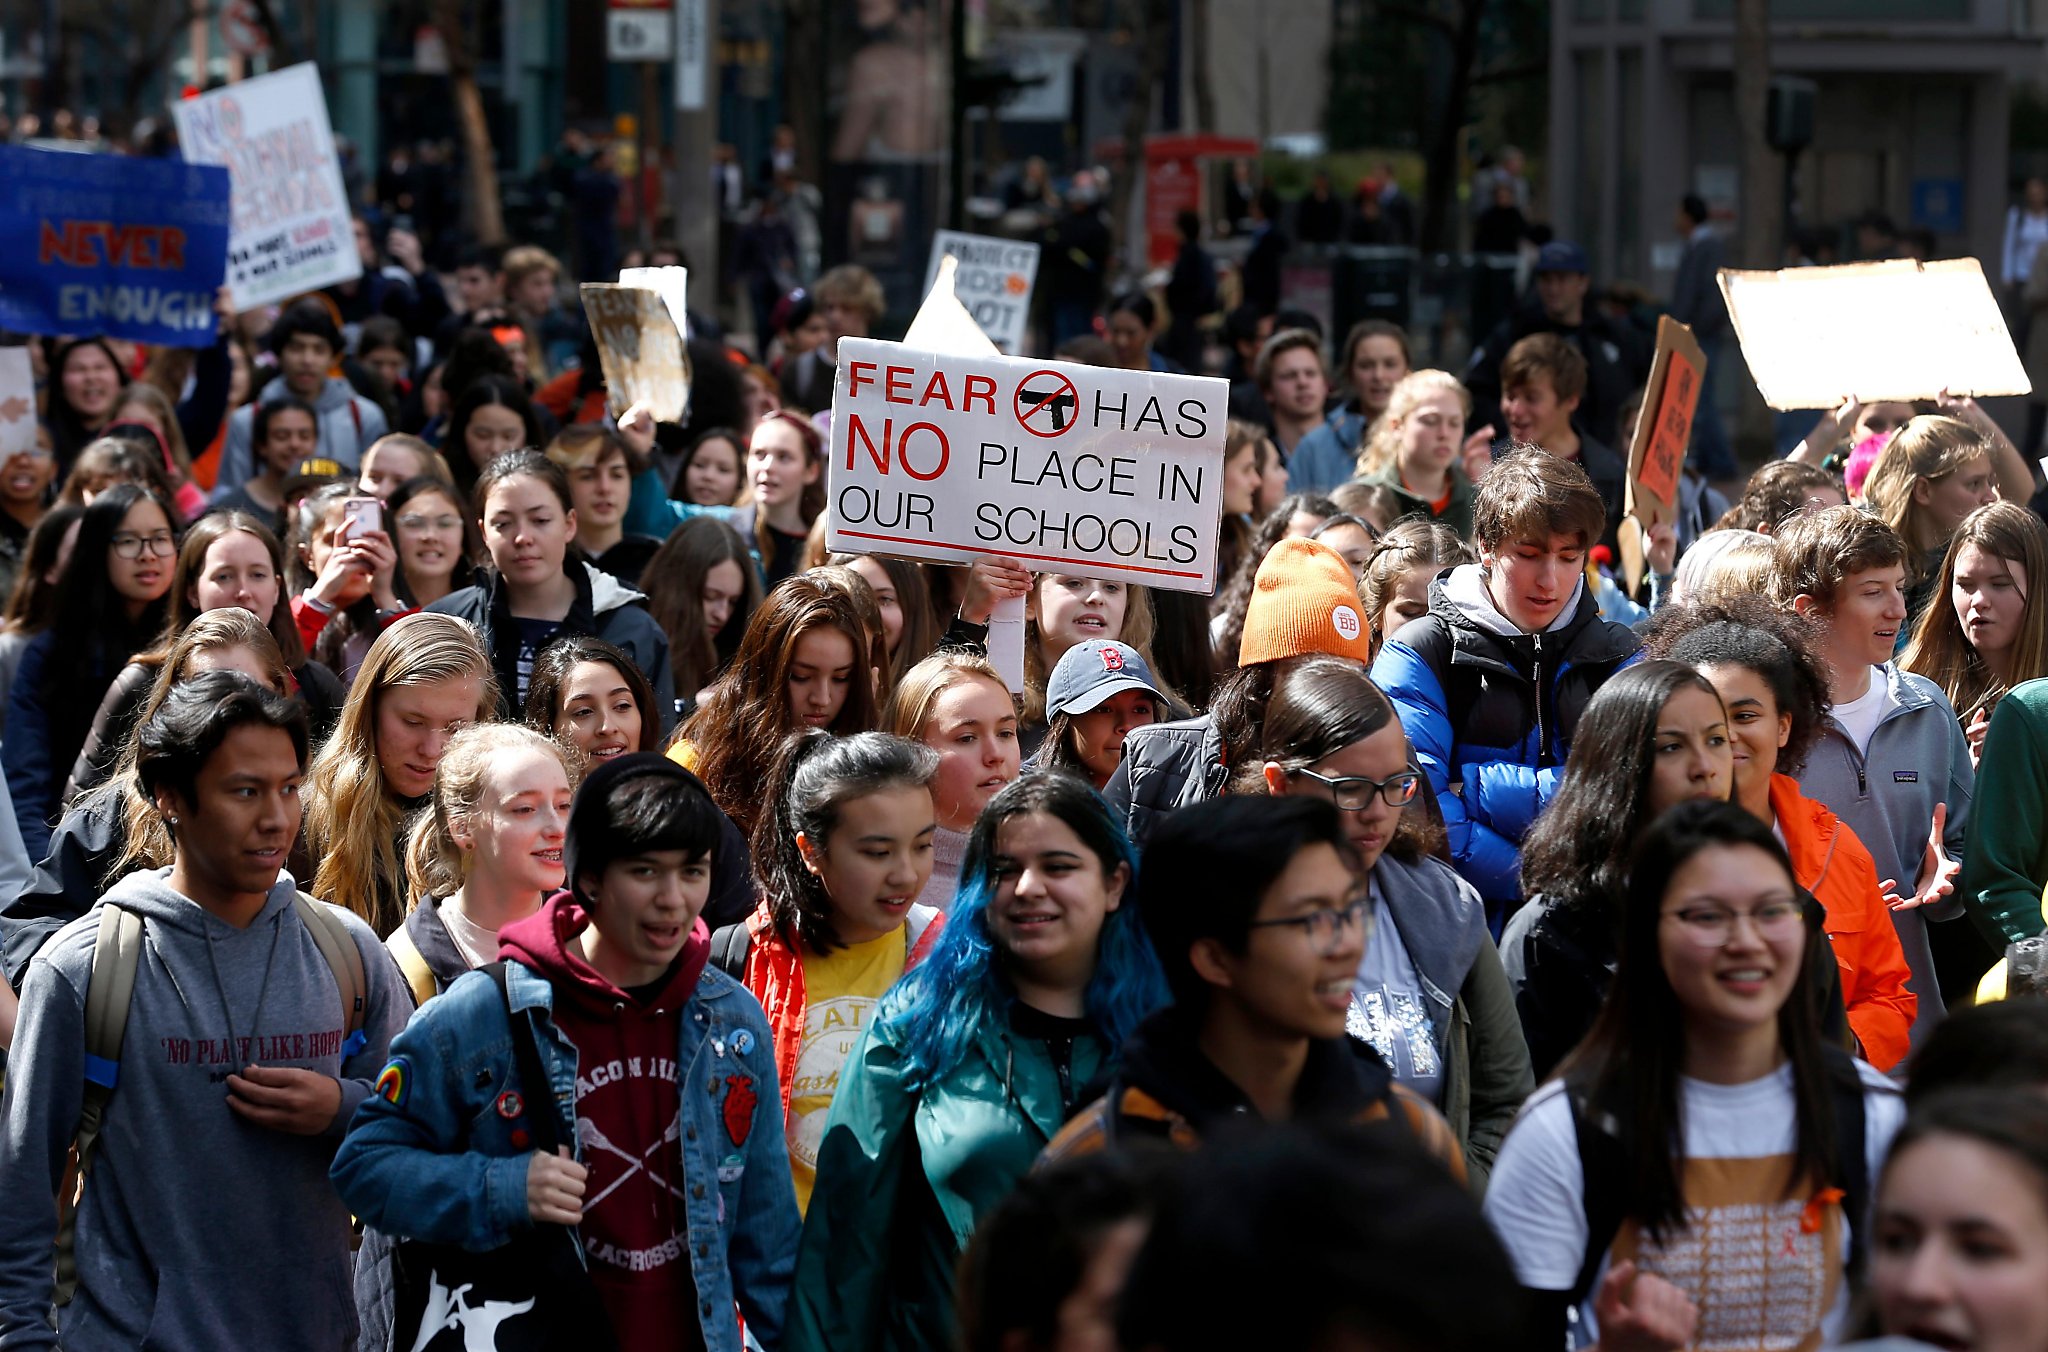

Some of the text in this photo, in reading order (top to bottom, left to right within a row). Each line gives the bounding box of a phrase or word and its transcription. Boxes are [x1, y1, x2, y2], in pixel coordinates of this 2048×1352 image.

[39, 218, 188, 271] NEVER
[958, 270, 1004, 297] IDS
[58, 284, 212, 331] ENOUGH
[973, 300, 1018, 333] OT
[849, 361, 1208, 439] FEAR HAS
[846, 414, 1203, 504] NO PLACE IN
[838, 486, 1198, 564] OUR SCHOOLS
[1098, 647, 1122, 671] B
[259, 1034, 304, 1061] LIKE
